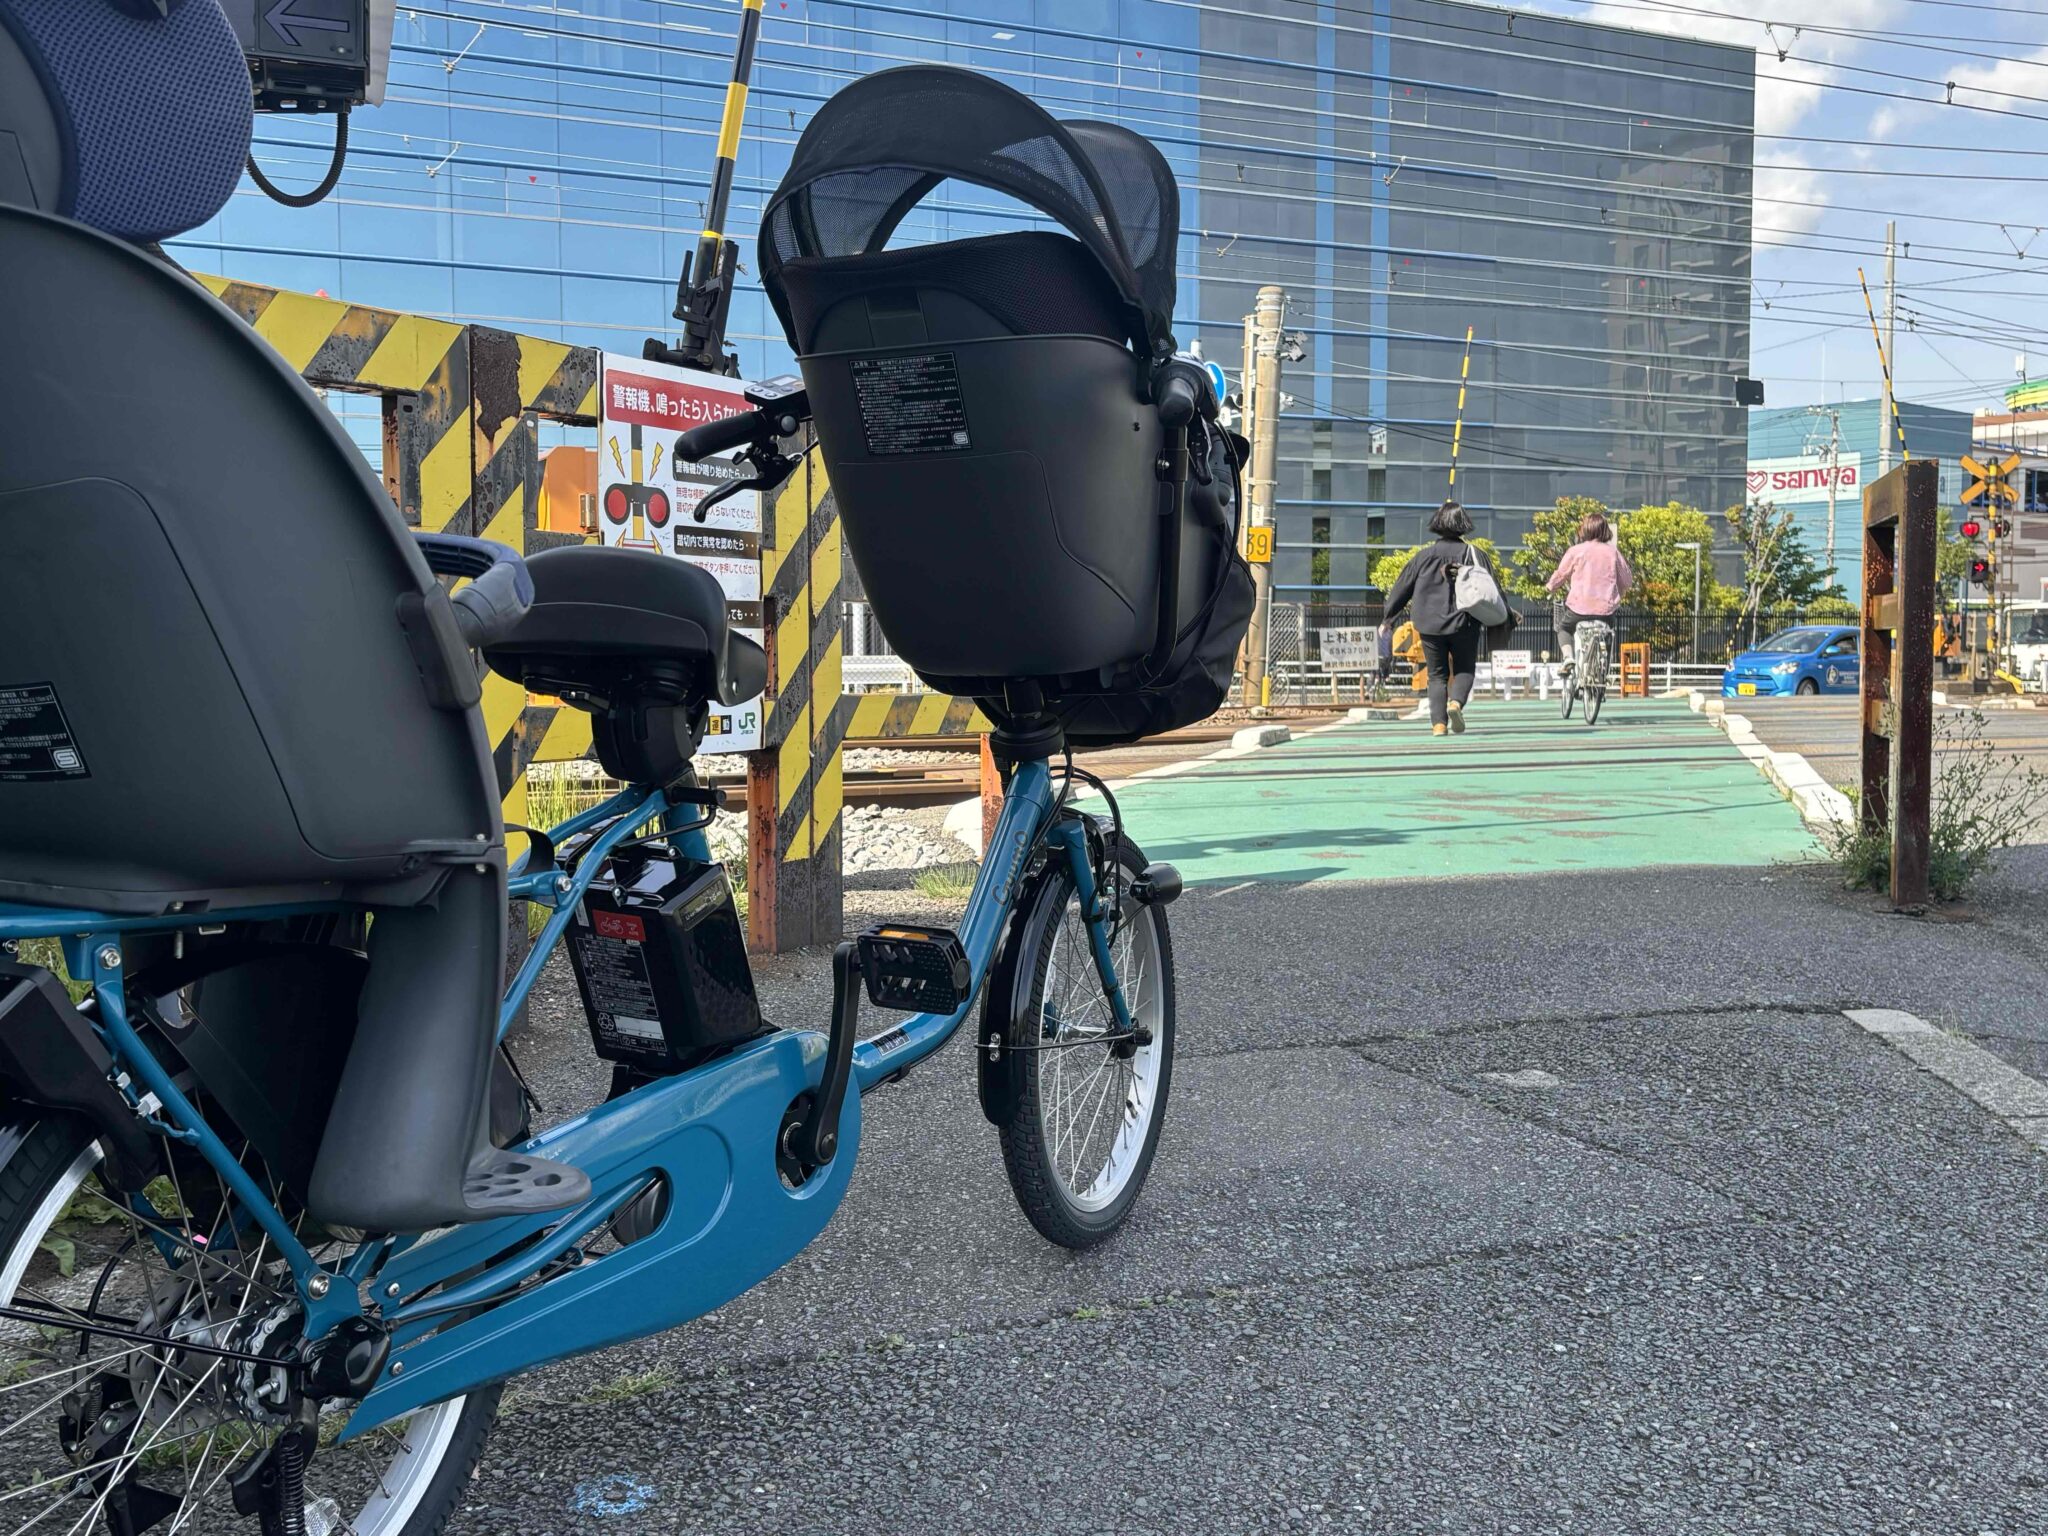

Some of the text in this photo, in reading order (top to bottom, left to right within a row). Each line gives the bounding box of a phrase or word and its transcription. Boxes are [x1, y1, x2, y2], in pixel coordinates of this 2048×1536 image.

[1772, 467, 1857, 490] sanwa
[1323, 631, 1374, 643] 上村踏切
[738, 712, 756, 730] JR
